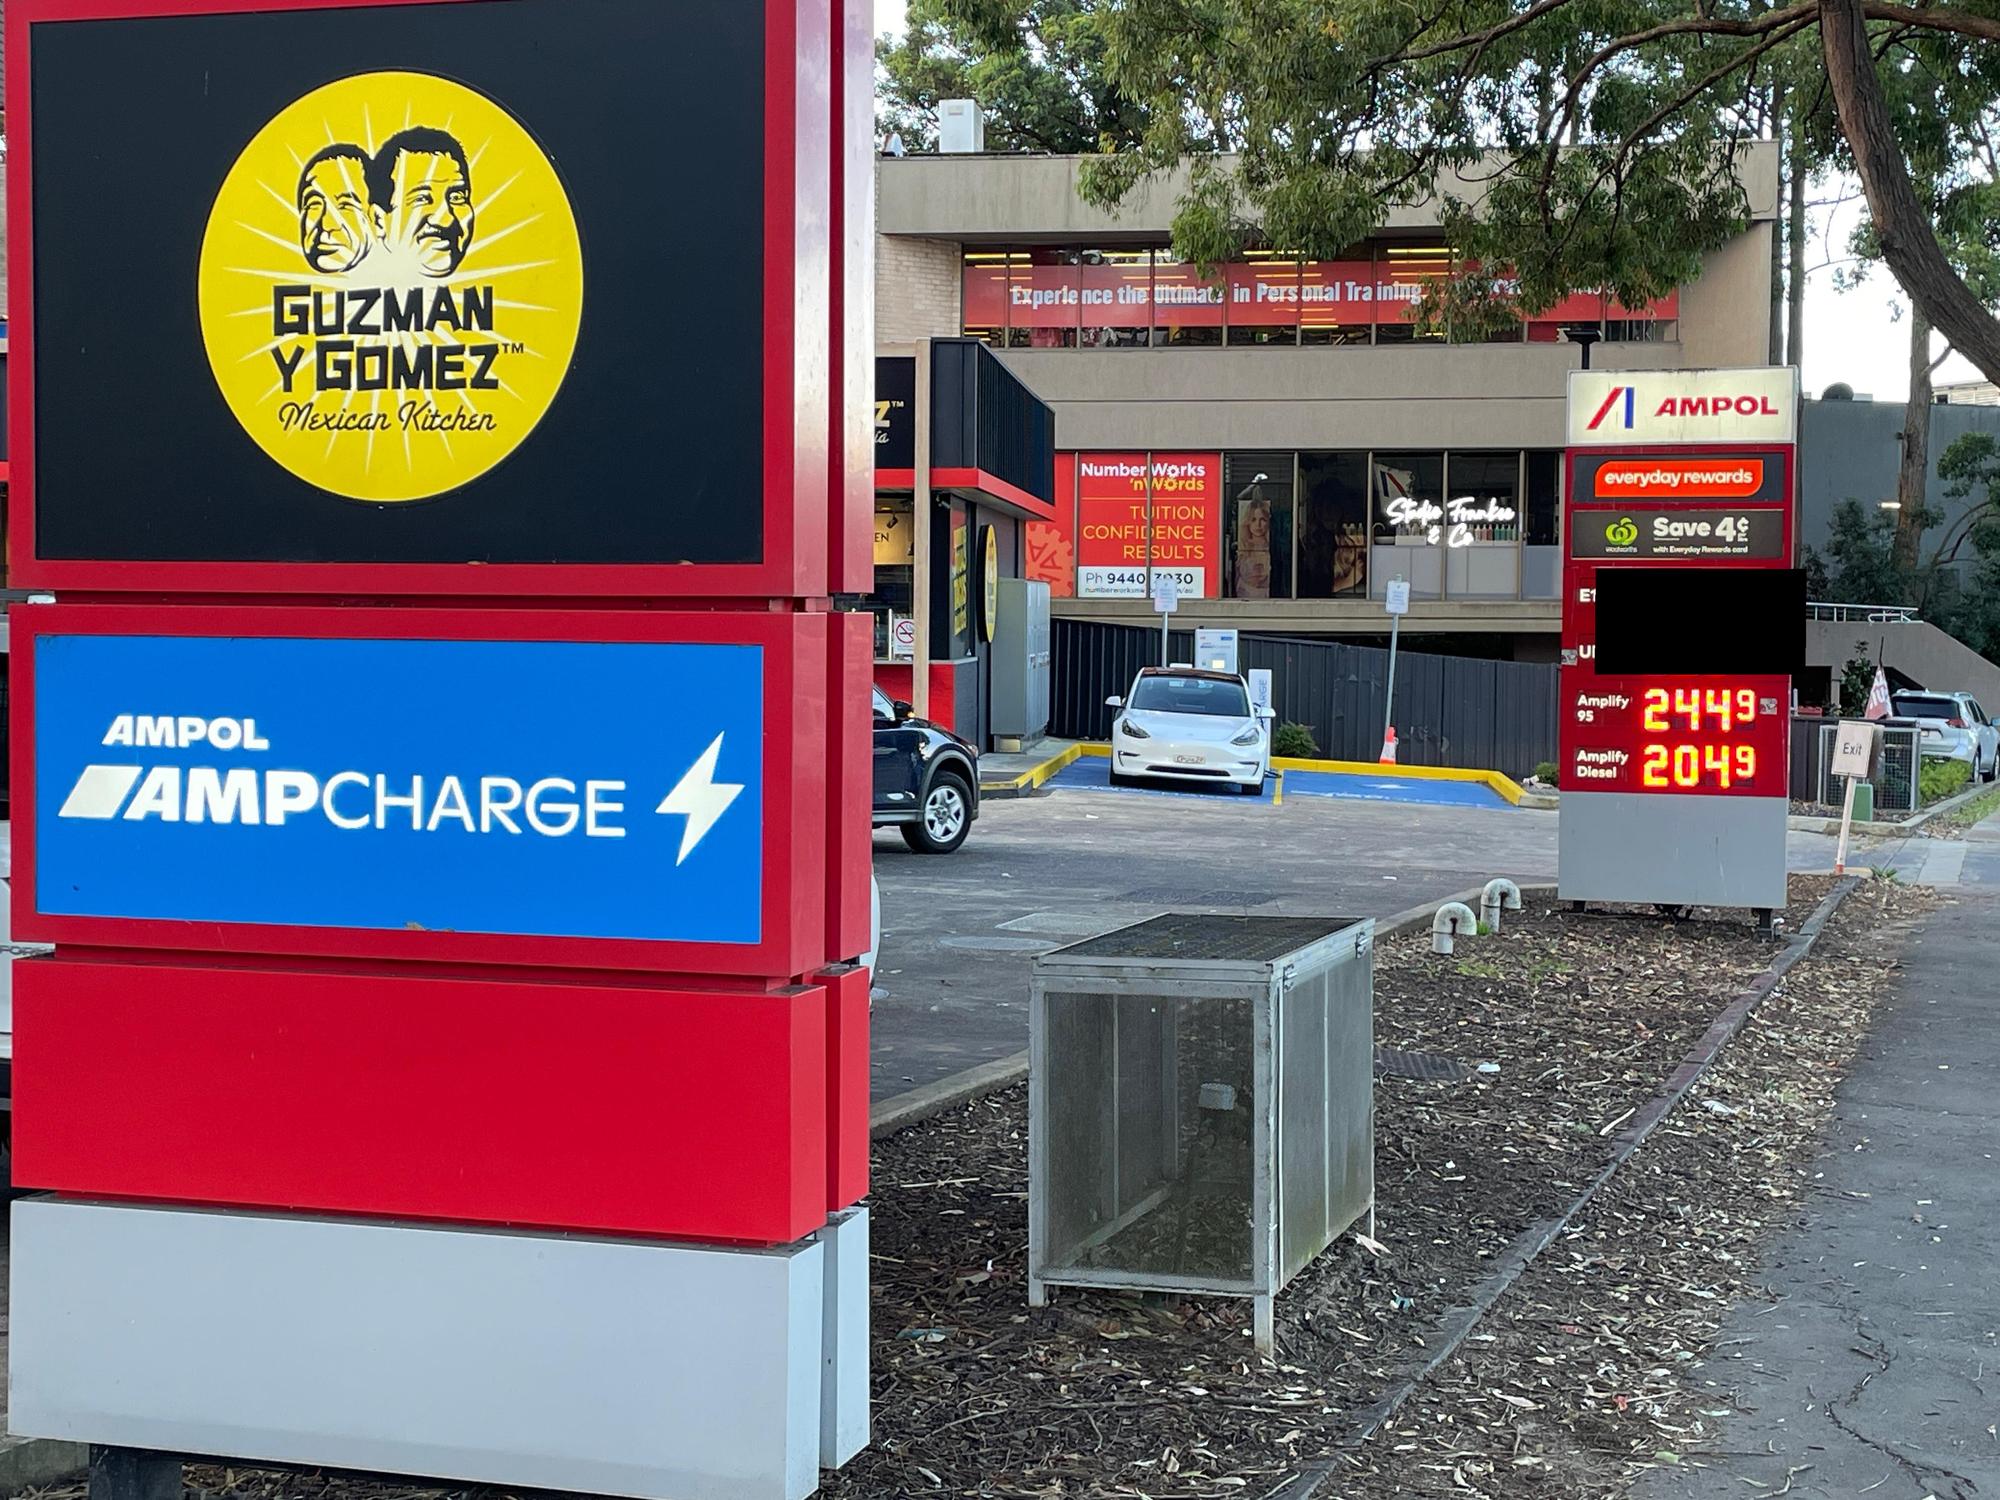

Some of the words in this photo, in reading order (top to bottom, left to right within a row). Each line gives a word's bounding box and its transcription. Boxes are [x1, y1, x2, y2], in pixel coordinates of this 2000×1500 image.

[1011, 285, 1113, 310] Experience
[1117, 285, 1148, 305] the
[1233, 282, 1250, 303] in
[1256, 281, 1341, 303] Personal
[1345, 281, 1422, 305] Training
[273, 284, 494, 336] GUZMAN
[270, 344, 305, 392] Y
[316, 340, 500, 391] GOMEZ
[1654, 396, 1780, 417] AMPOL
[278, 400, 391, 432] Mexican
[397, 400, 498, 432] Kitchen
[1604, 469, 1682, 488] everyday
[1683, 468, 1754, 485] rewards
[1129, 505, 1205, 520] TUITION
[1082, 525, 1205, 540] CONFIDENCE
[1652, 516, 1712, 537] Save
[1123, 545, 1205, 560] RESULTS
[1086, 572, 1103, 584] Ph
[1107, 572, 1146, 585] 9440
[1577, 694, 1630, 710] Amplify
[1576, 709, 1595, 723] 95
[101, 714, 270, 750] AMPOL
[1576, 749, 1630, 766] Amplify
[1842, 742, 1863, 756] Exit
[1576, 765, 1618, 779] Diesel
[123, 767, 627, 839] AMPCHARGE
